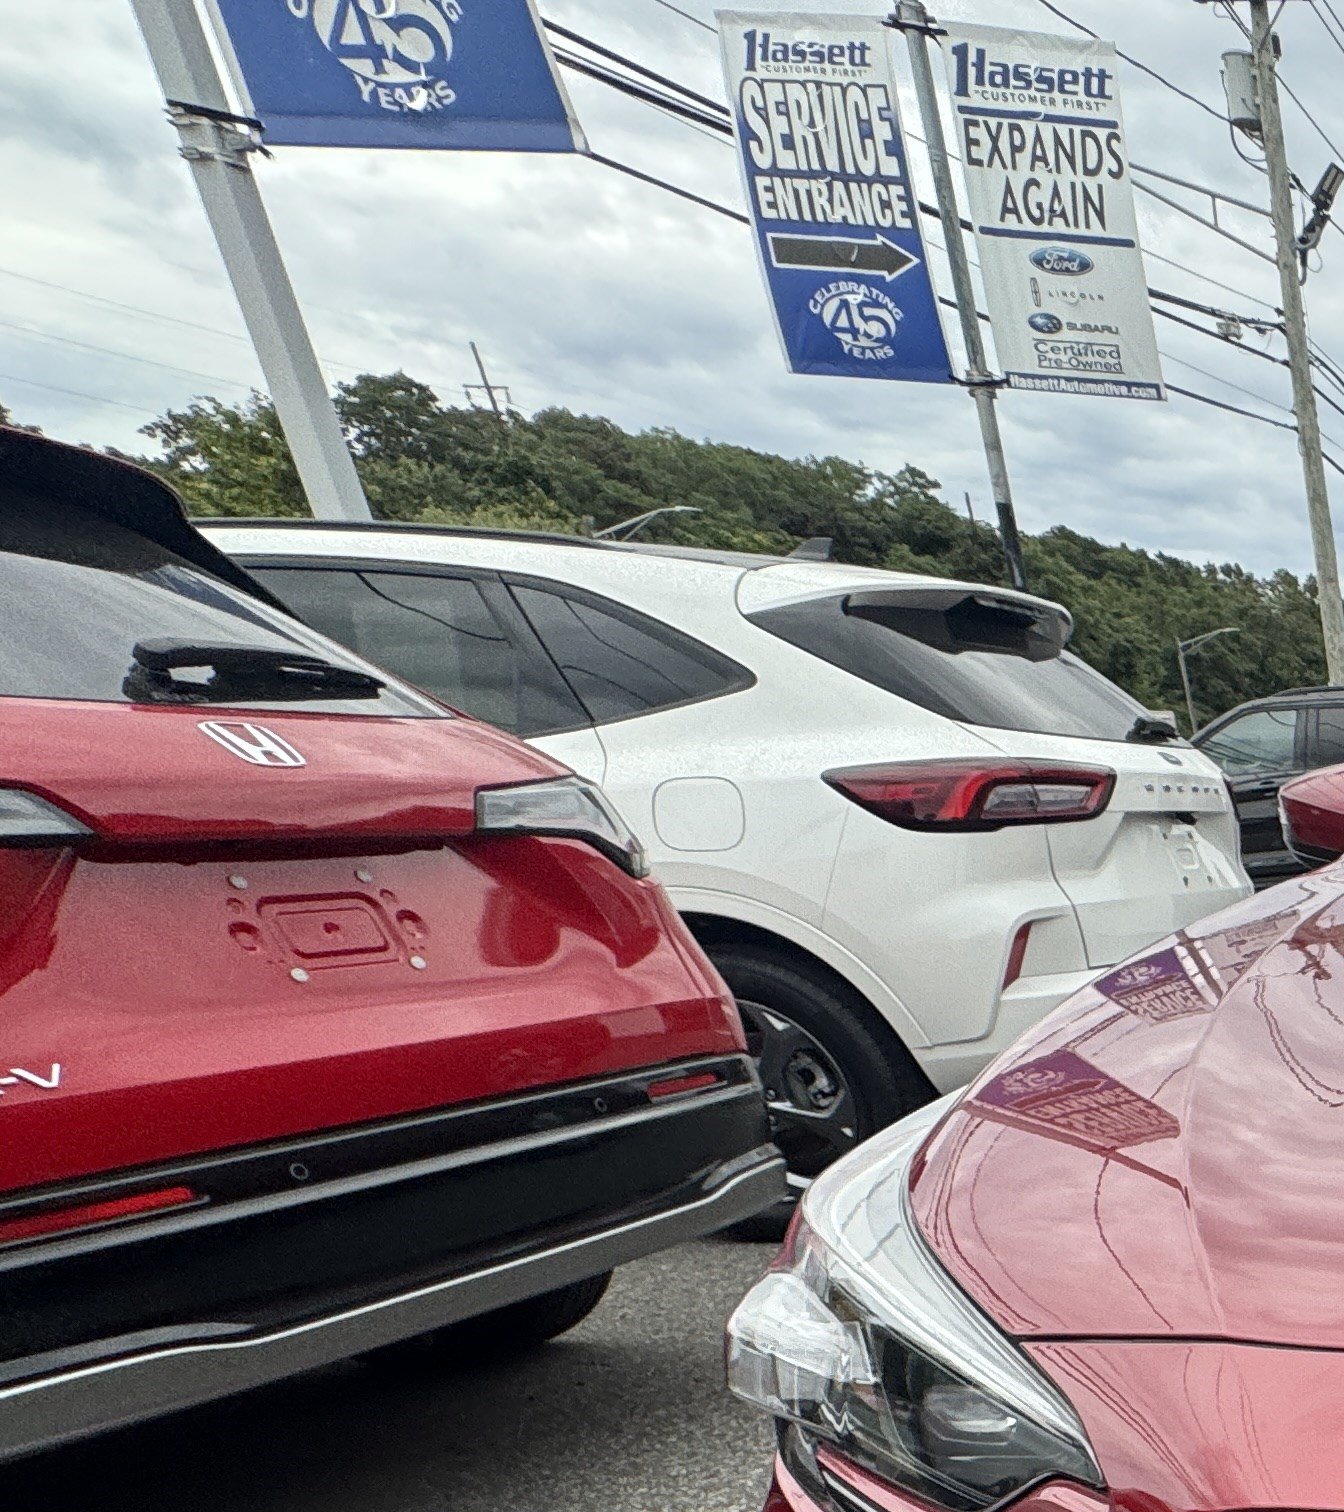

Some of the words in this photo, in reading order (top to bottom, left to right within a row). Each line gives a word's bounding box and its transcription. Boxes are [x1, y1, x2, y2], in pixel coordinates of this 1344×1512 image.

[743, 29, 871, 72] Hassett
[952, 42, 1113, 101] Hassett
[353, 73, 456, 112] YEARS
[740, 77, 900, 178] SERVICE
[963, 118, 1124, 180] EXPANDS
[755, 176, 912, 229] ENTRANCE
[1000, 176, 1107, 231] AGAIN
[809, 281, 904, 321] CELEBRATING
[1048, 290, 1104, 301] LINCOLN
[829, 299, 897, 346] 45
[1066, 322, 1120, 335] SUBARU
[841, 339, 895, 361] YEARS
[1034, 341, 1121, 360] Certified
[1037, 354, 1123, 372] Pre-Owned
